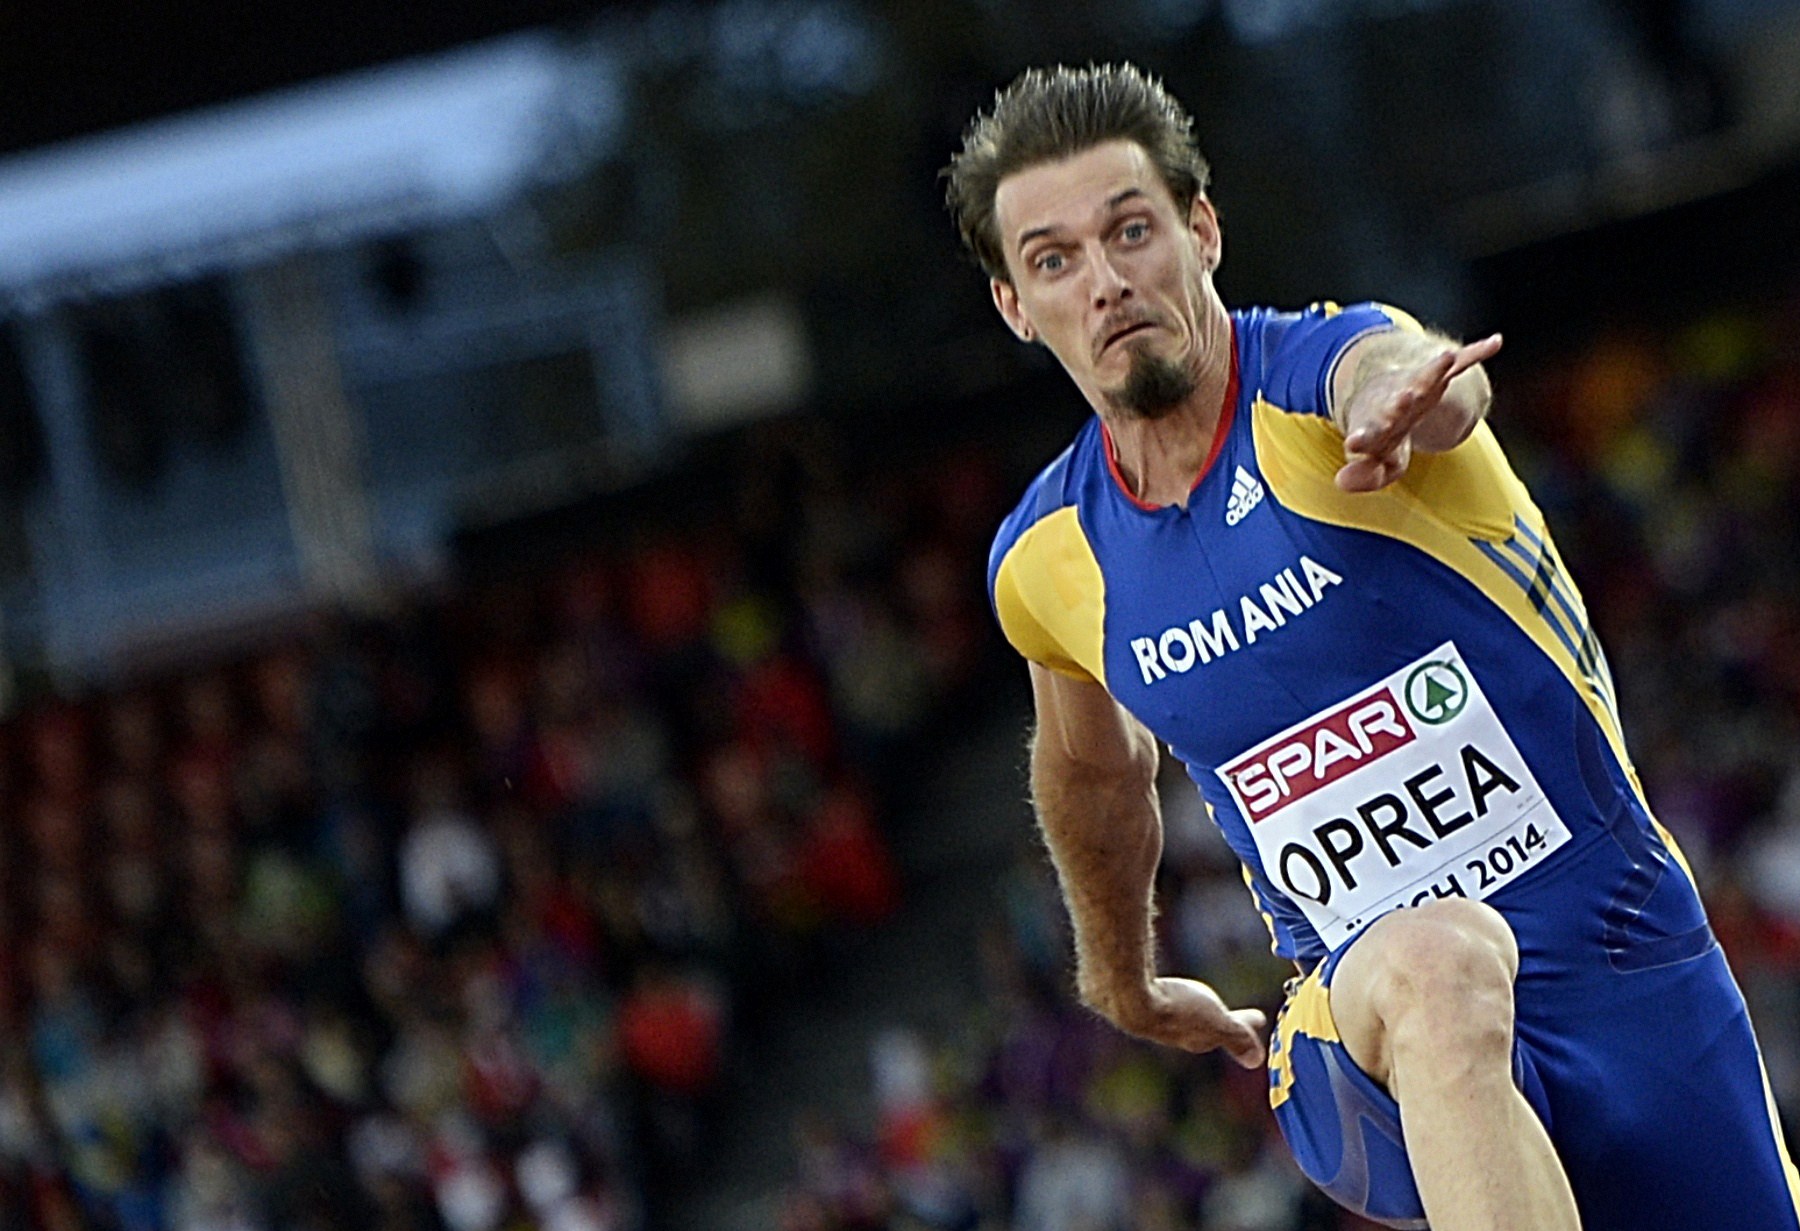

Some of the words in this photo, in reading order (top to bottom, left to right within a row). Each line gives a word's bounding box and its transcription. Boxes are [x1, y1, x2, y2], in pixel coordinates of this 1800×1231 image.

[1225, 481, 1264, 526] adida
[1130, 555, 1343, 685] ROMANIA
[1236, 699, 1406, 813] SPAR
[1279, 743, 1522, 906] OPREA
[1466, 822, 1547, 890] 2014
